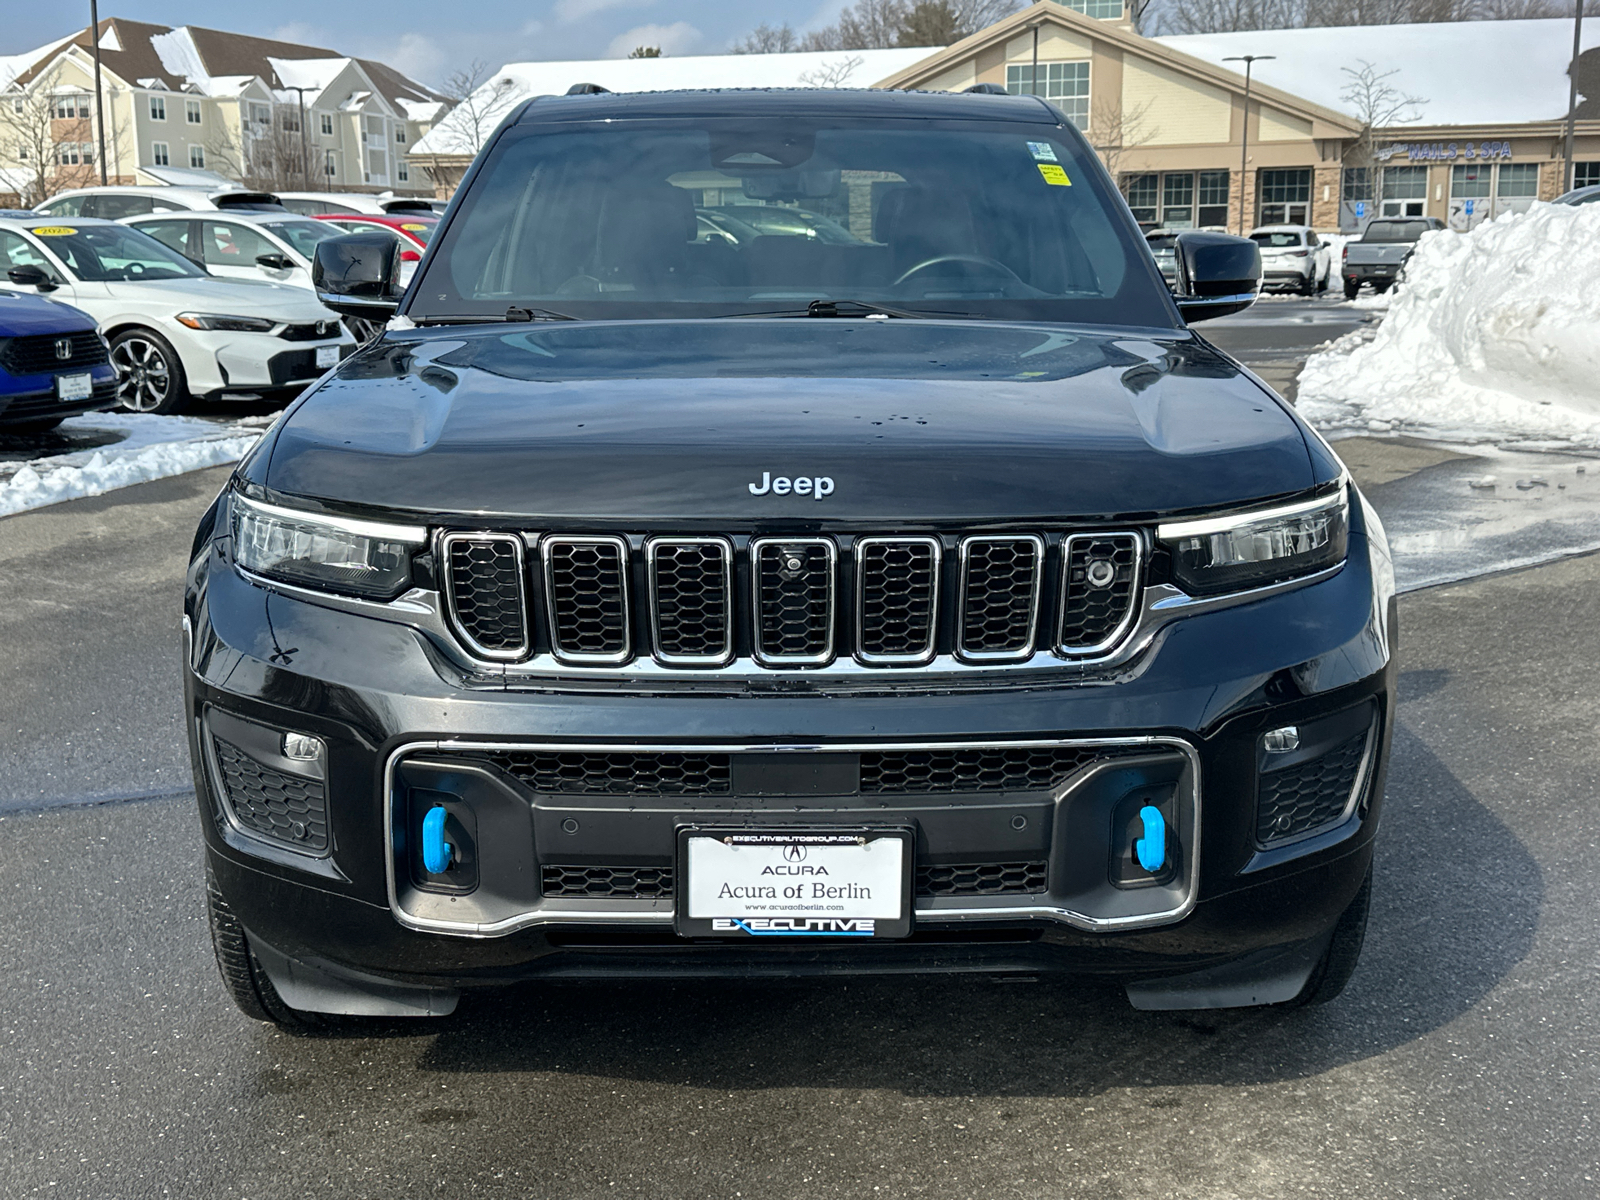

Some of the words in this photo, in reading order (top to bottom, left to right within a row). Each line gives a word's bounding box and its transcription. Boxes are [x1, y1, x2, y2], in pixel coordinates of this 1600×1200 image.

[1407, 143, 1458, 160] NAILS
[1464, 142, 1476, 158] &
[1480, 141, 1512, 158] SPA
[748, 471, 835, 500] Jeep
[760, 865, 829, 876] ACURA
[717, 882, 777, 899] Acura
[783, 884, 804, 899] of
[811, 882, 871, 899] Berlin
[745, 903, 844, 911] www.acuraofberlin.com
[712, 918, 875, 931] EXECUTIVE
